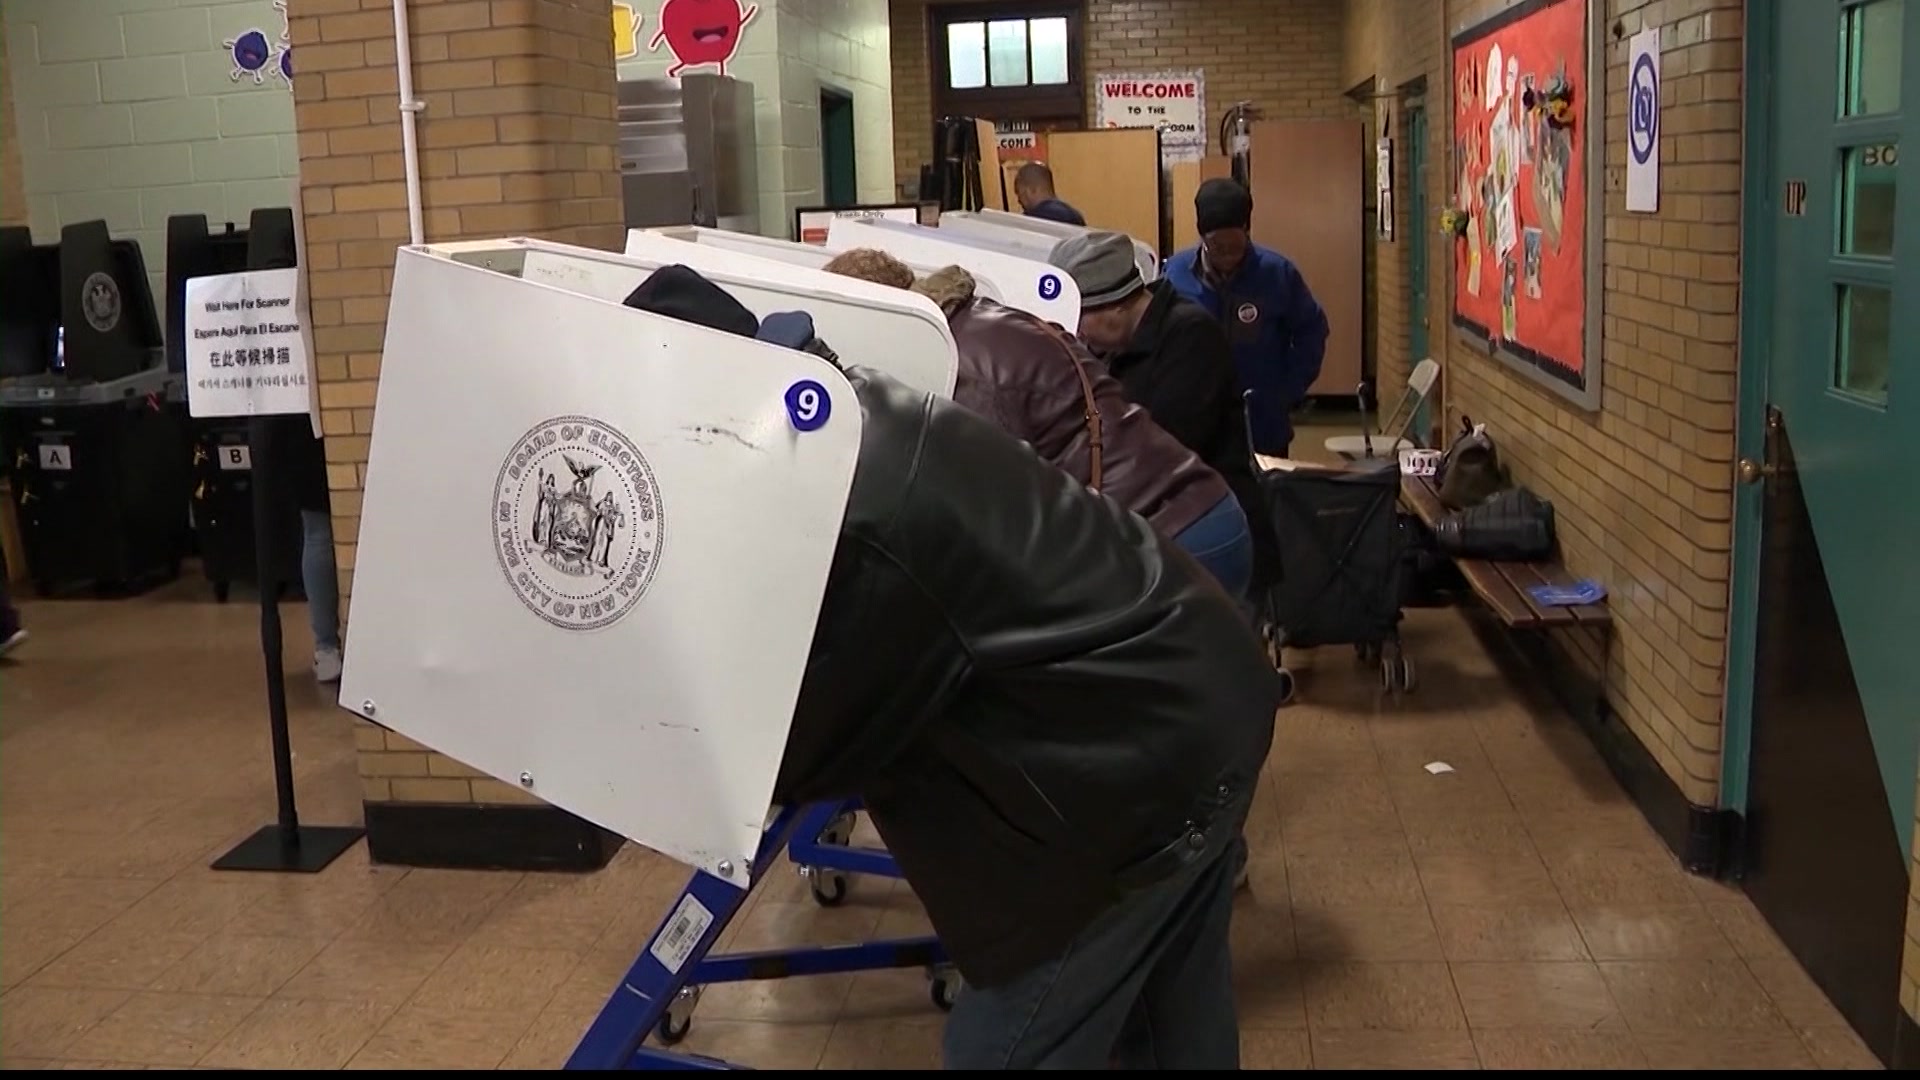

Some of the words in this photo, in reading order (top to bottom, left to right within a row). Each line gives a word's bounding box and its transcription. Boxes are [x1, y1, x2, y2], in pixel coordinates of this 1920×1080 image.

[1105, 83, 1195, 98] WELCOME
[1128, 106, 1141, 115] TO
[1147, 106, 1166, 115] THE
[1165, 123, 1195, 132] OOM
[1000, 137, 1032, 149] COME
[1786, 181, 1806, 215] UP
[1044, 278, 1055, 295] 9
[222, 300, 239, 311] Here
[241, 298, 254, 310] For
[256, 297, 290, 309] Scanner
[240, 324, 257, 336] Para
[797, 388, 819, 421] 9
[49, 450, 62, 465] A
[230, 449, 242, 464] B
[508, 429, 557, 480] BOARD
[561, 425, 584, 441] OF
[588, 429, 655, 521] ELECTIONS
[499, 501, 511, 522] IN
[501, 527, 521, 568] THE
[616, 547, 651, 597] YORK
[517, 572, 552, 608] CITY
[553, 601, 575, 617] OF
[579, 594, 616, 620] NEW
